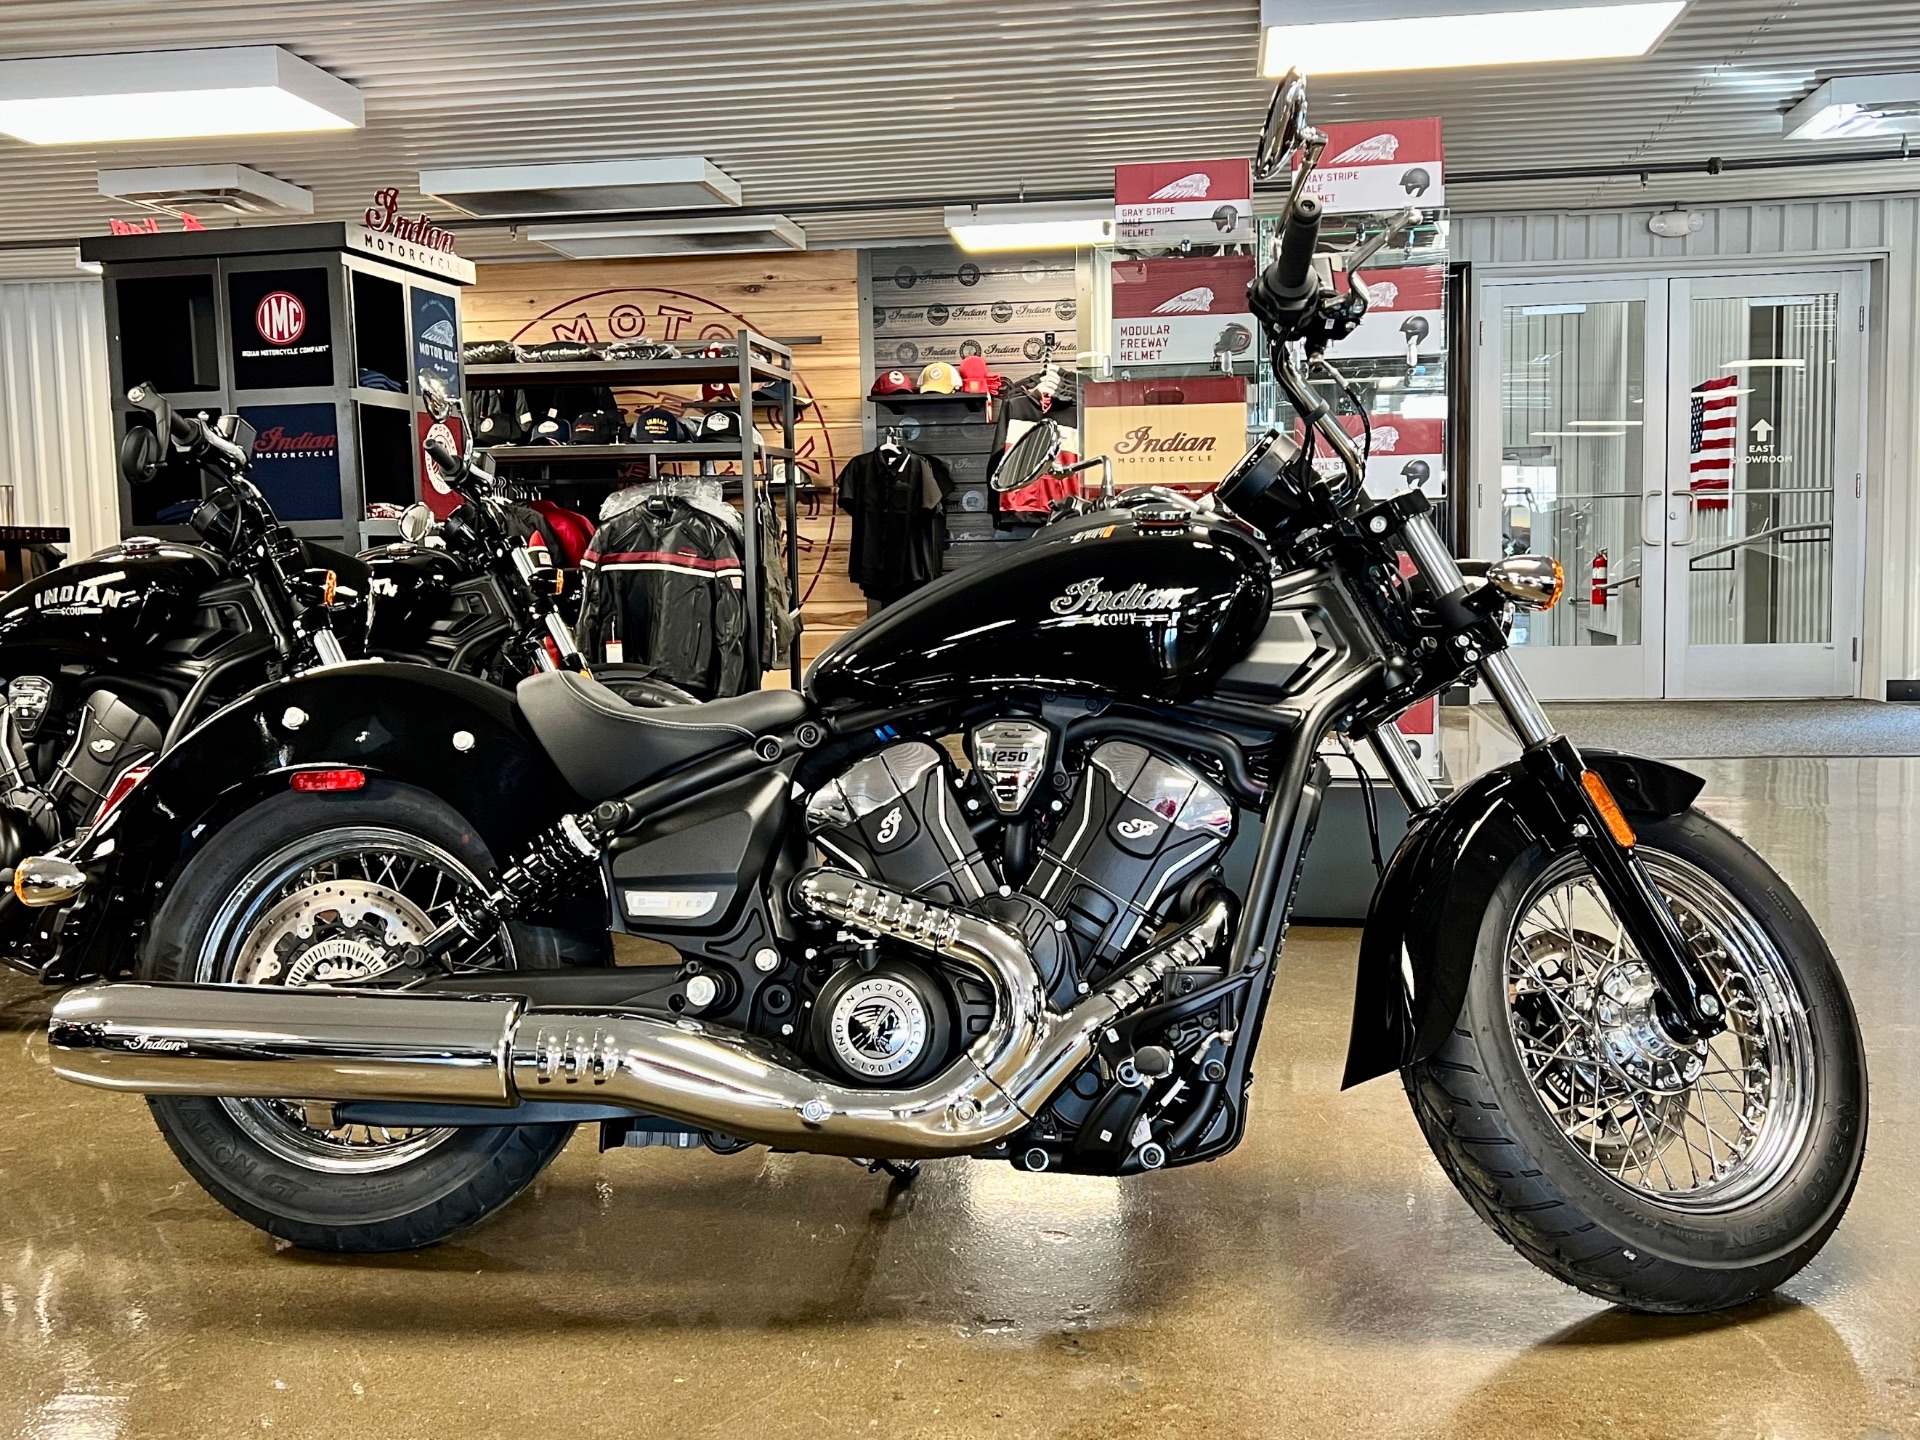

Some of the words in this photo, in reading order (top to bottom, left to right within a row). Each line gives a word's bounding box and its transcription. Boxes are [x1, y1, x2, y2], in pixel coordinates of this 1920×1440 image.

[1306, 173, 1323, 183] RAY
[1327, 171, 1359, 181] STRIPE
[1122, 208, 1144, 217] GRAY
[1146, 207, 1175, 215] STRIPE
[365, 187, 456, 255] Indian
[1122, 228, 1154, 237] HELMET
[364, 233, 461, 275] MOTORCYCLE
[889, 308, 924, 320] Indian
[951, 306, 988, 317] Indian
[1015, 304, 1052, 315] Indian
[263, 296, 300, 339] IMC
[1120, 325, 1170, 336] MODULAR
[983, 343, 1020, 355] Indian
[1120, 338, 1169, 348] FREEWAY
[260, 348, 298, 356] MOTORCYCLE
[300, 345, 326, 354] COMPANY
[419, 341, 443, 360] MOTOR
[920, 346, 957, 357] Indian
[1120, 350, 1162, 361] HELMET
[253, 426, 336, 452] Indian
[1113, 425, 1217, 455] Indian
[256, 450, 334, 459] MOTORCYCLE
[1749, 445, 1775, 453] EAST
[1117, 455, 1213, 464] MOTORCYCLE
[1731, 455, 1793, 464] SHOWROOM
[34, 585, 120, 609] INDIAN
[1050, 576, 1186, 614] Indian
[61, 607, 84, 615] SCOUT
[1094, 612, 1136, 626] SCOUT
[991, 751, 1029, 763] 1250
[835, 994, 856, 1055] INDIAN
[861, 983, 922, 1057] MOTORCYCLE
[125, 1034, 184, 1052] Indian
[861, 1062, 893, 1073] 1901
